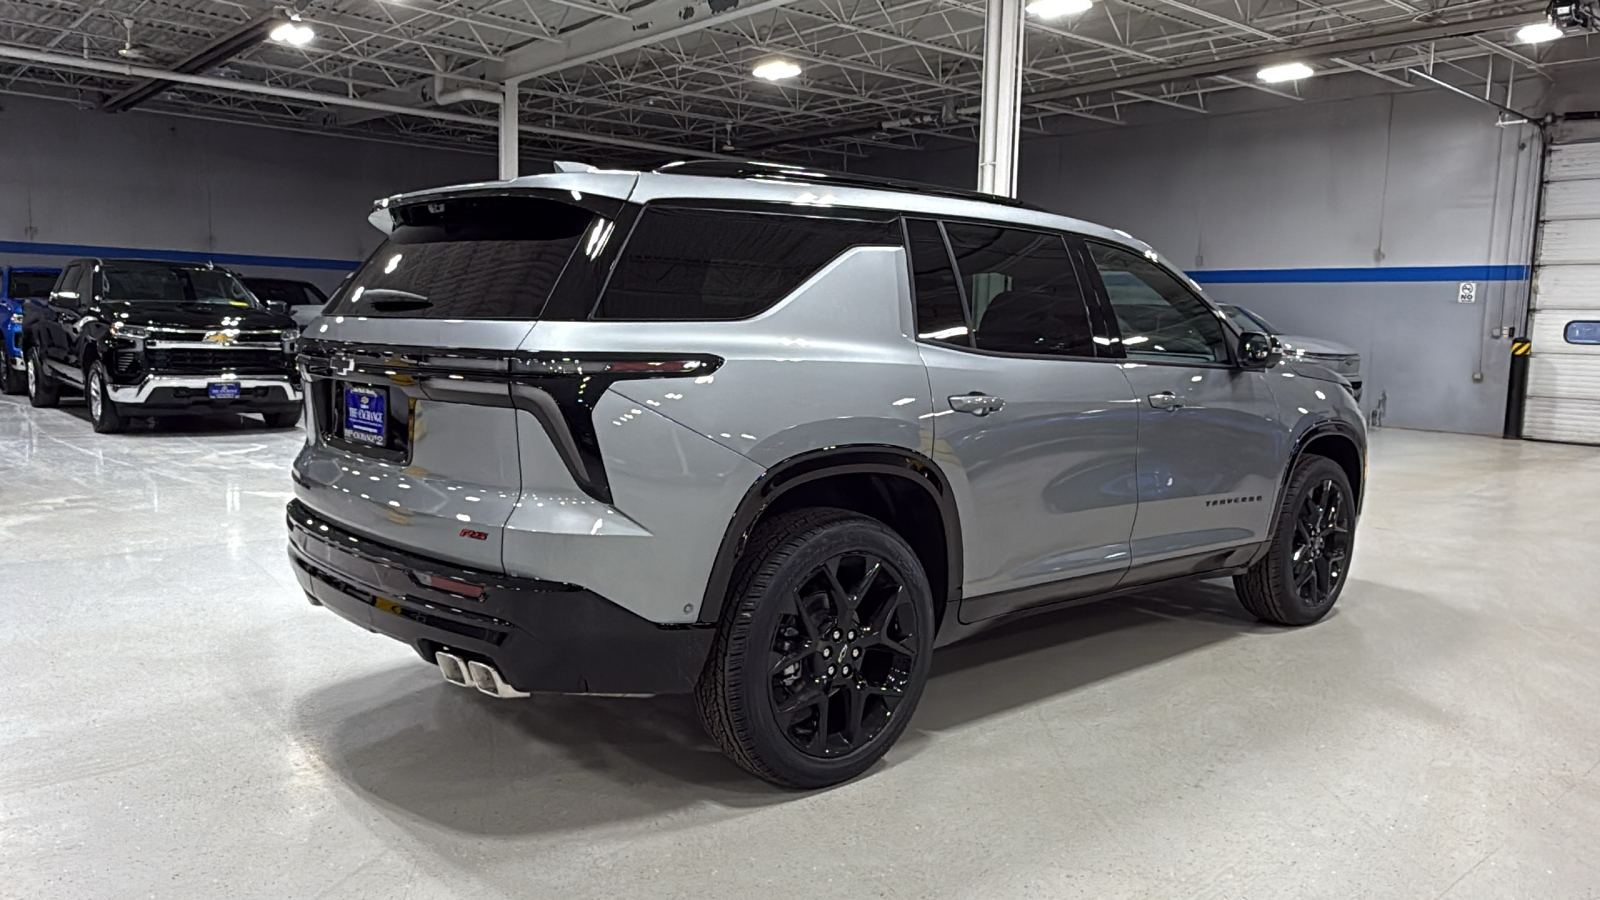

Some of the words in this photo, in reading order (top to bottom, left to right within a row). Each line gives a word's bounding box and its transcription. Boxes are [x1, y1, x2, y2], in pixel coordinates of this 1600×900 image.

[349, 407, 358, 418] THE
[1205, 495, 1262, 507] TRAVERSE
[460, 529, 488, 540] RS
